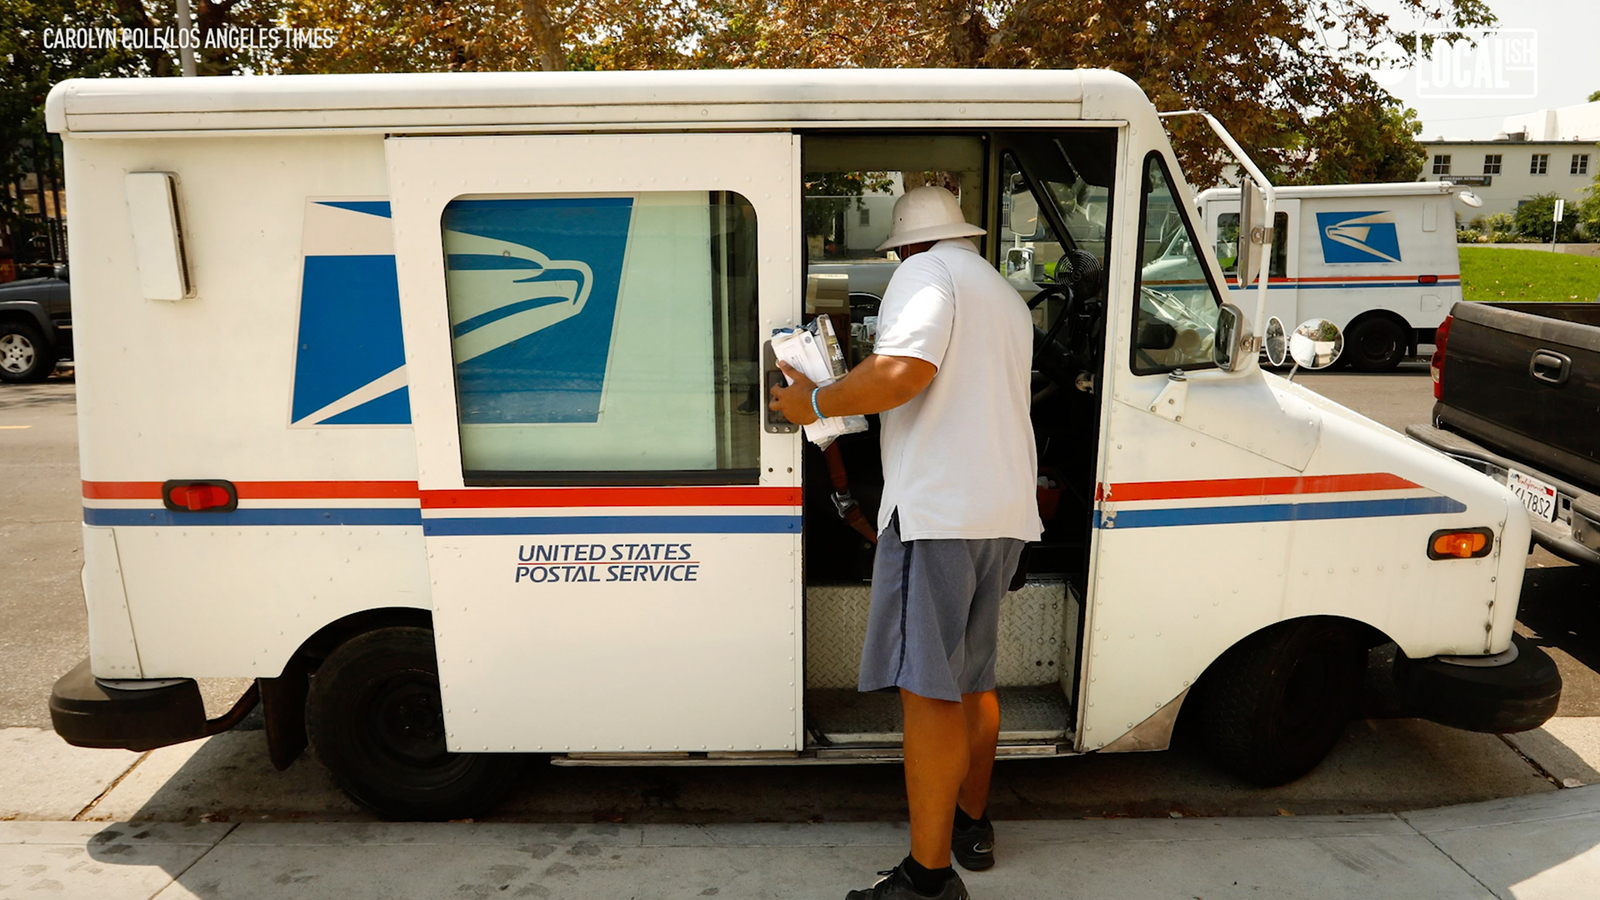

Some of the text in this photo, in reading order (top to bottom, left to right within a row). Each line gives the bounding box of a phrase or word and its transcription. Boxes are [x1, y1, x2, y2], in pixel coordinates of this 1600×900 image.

[518, 543, 691, 562] UNITED STATES
[515, 565, 698, 583] POSTAL SERVICE
